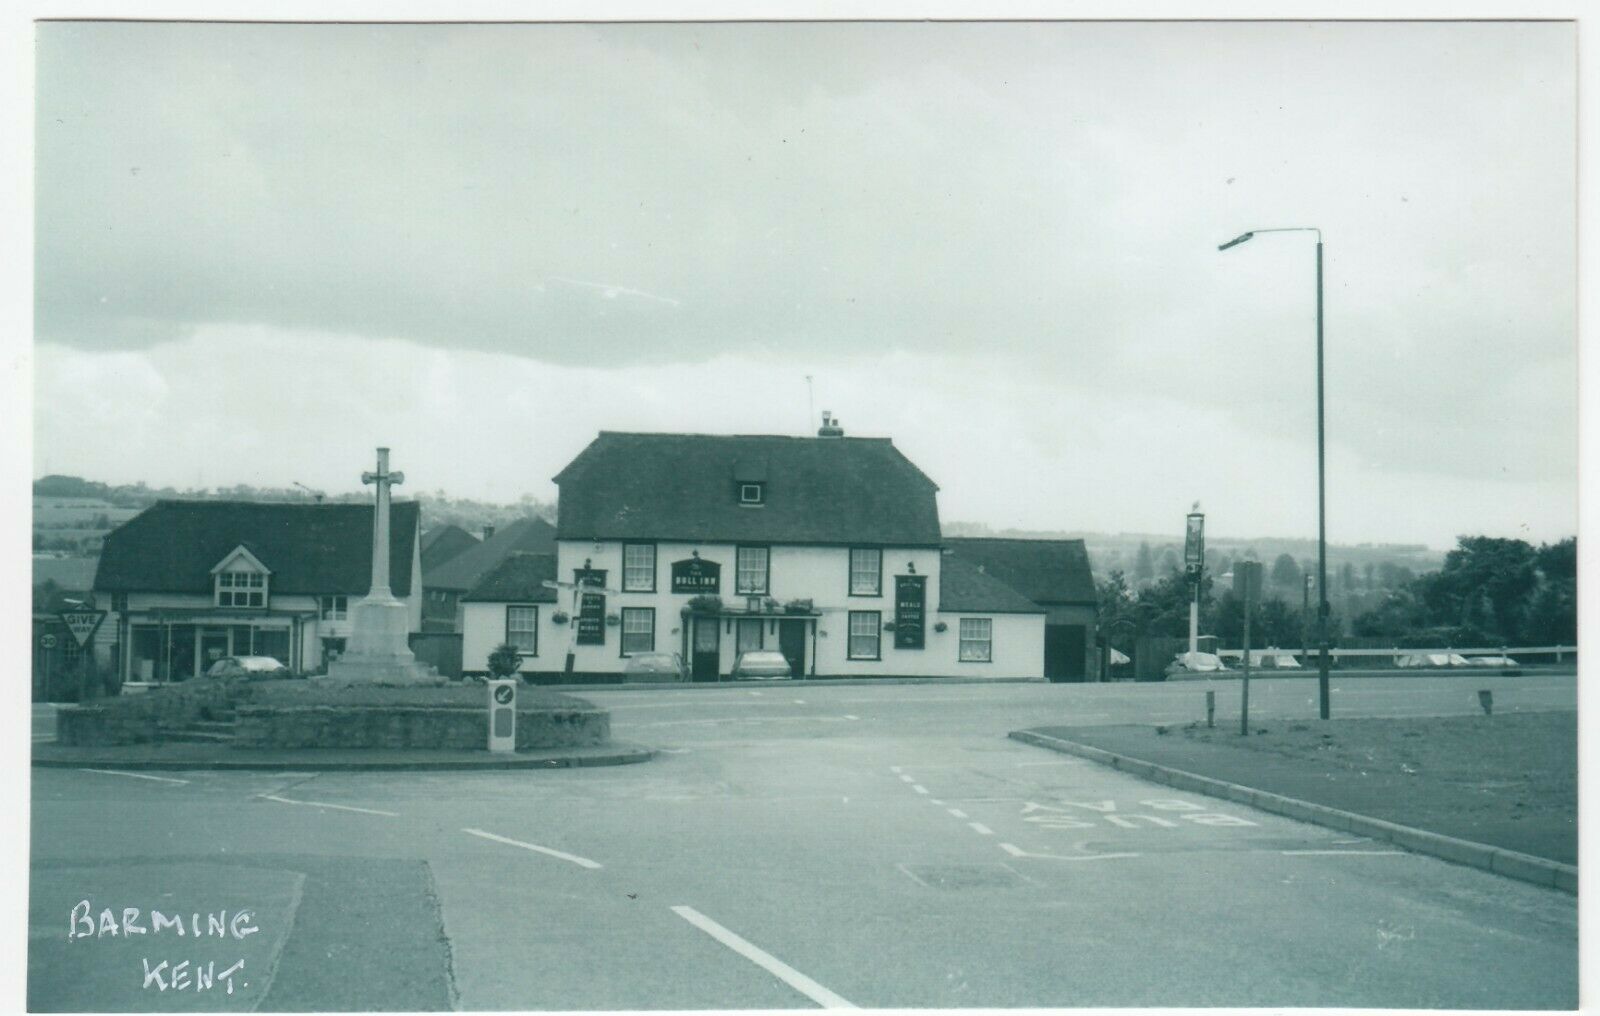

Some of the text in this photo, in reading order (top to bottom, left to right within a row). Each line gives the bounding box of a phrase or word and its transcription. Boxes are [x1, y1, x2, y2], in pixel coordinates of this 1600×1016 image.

[676, 576, 716, 585] BULL INN
[67, 615, 96, 624] GIVE
